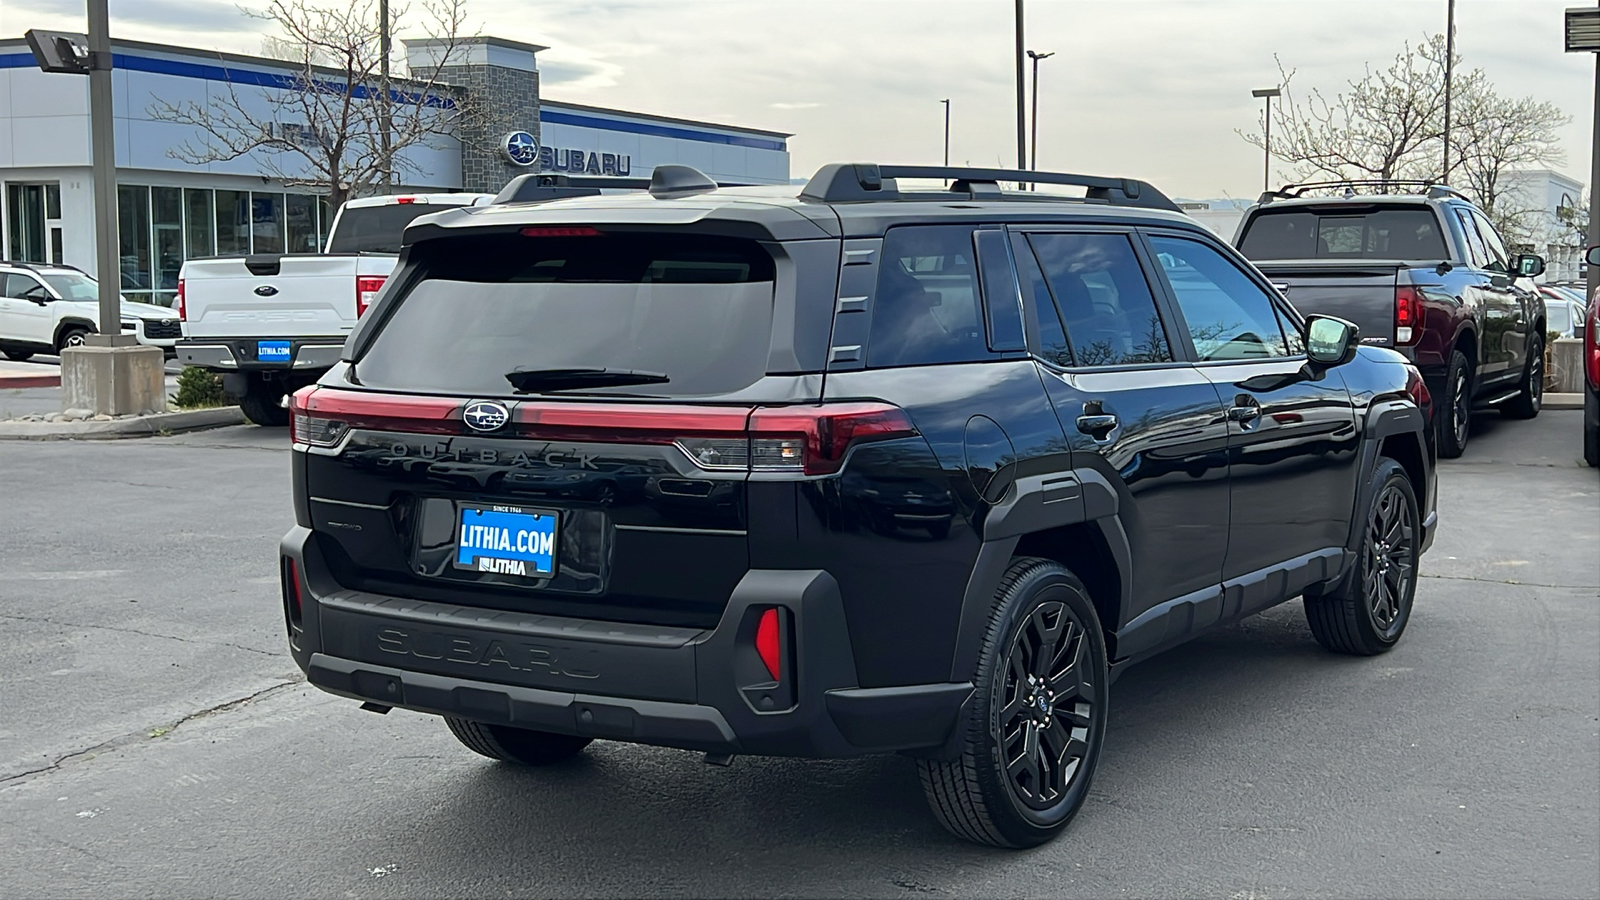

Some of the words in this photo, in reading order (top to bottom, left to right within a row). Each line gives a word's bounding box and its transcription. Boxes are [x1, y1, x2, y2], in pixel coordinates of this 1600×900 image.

[540, 145, 631, 176] SUBARU
[258, 346, 291, 356] LITHIA.COM
[390, 442, 600, 470] OUTBACK
[493, 505, 509, 513] SINCE
[460, 524, 554, 556] LITHIA.COM
[489, 558, 526, 576] LITHIA
[377, 627, 600, 679] SUBARU
